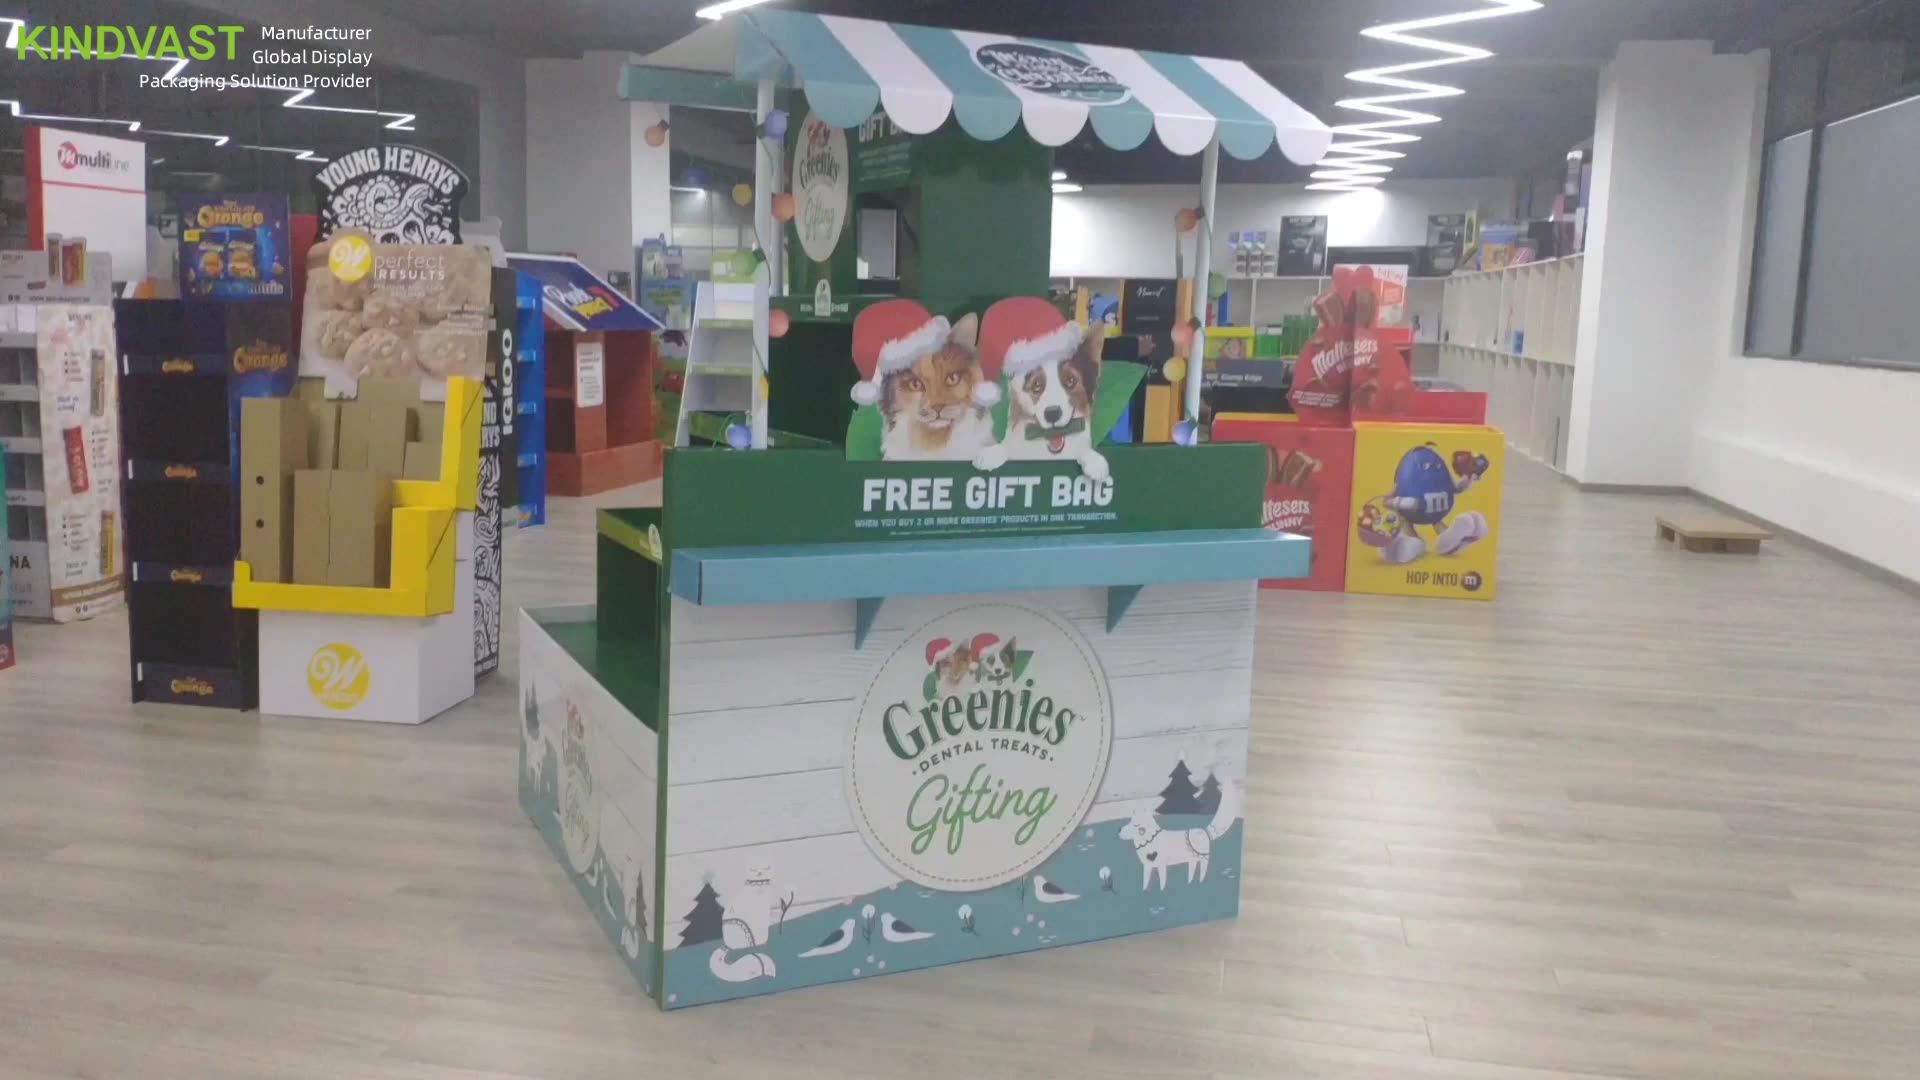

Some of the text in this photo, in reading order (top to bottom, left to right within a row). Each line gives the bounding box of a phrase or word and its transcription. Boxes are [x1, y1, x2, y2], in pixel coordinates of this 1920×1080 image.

[316, 146, 461, 195] YOUNG HENRYS
[374, 249, 445, 278] perfect
[378, 269, 445, 281] RESULTS
[502, 328, 513, 435] IGLOO
[863, 475, 1115, 512] FREE GIFT BAG
[855, 519, 879, 528] WHEN
[880, 518, 897, 528] YOU
[898, 518, 915, 527] BUY
[924, 517, 935, 526] OR
[936, 516, 959, 526] MORE
[1000, 514, 1040, 524] PRODUCTS
[1040, 513, 1049, 523] IN
[1405, 571, 1429, 586] HOP
[1432, 572, 1459, 586] INTO
[882, 679, 1076, 760] Greenies
[919, 738, 1048, 774] DENTAL TREATS
[906, 763, 1059, 856] Gifting
